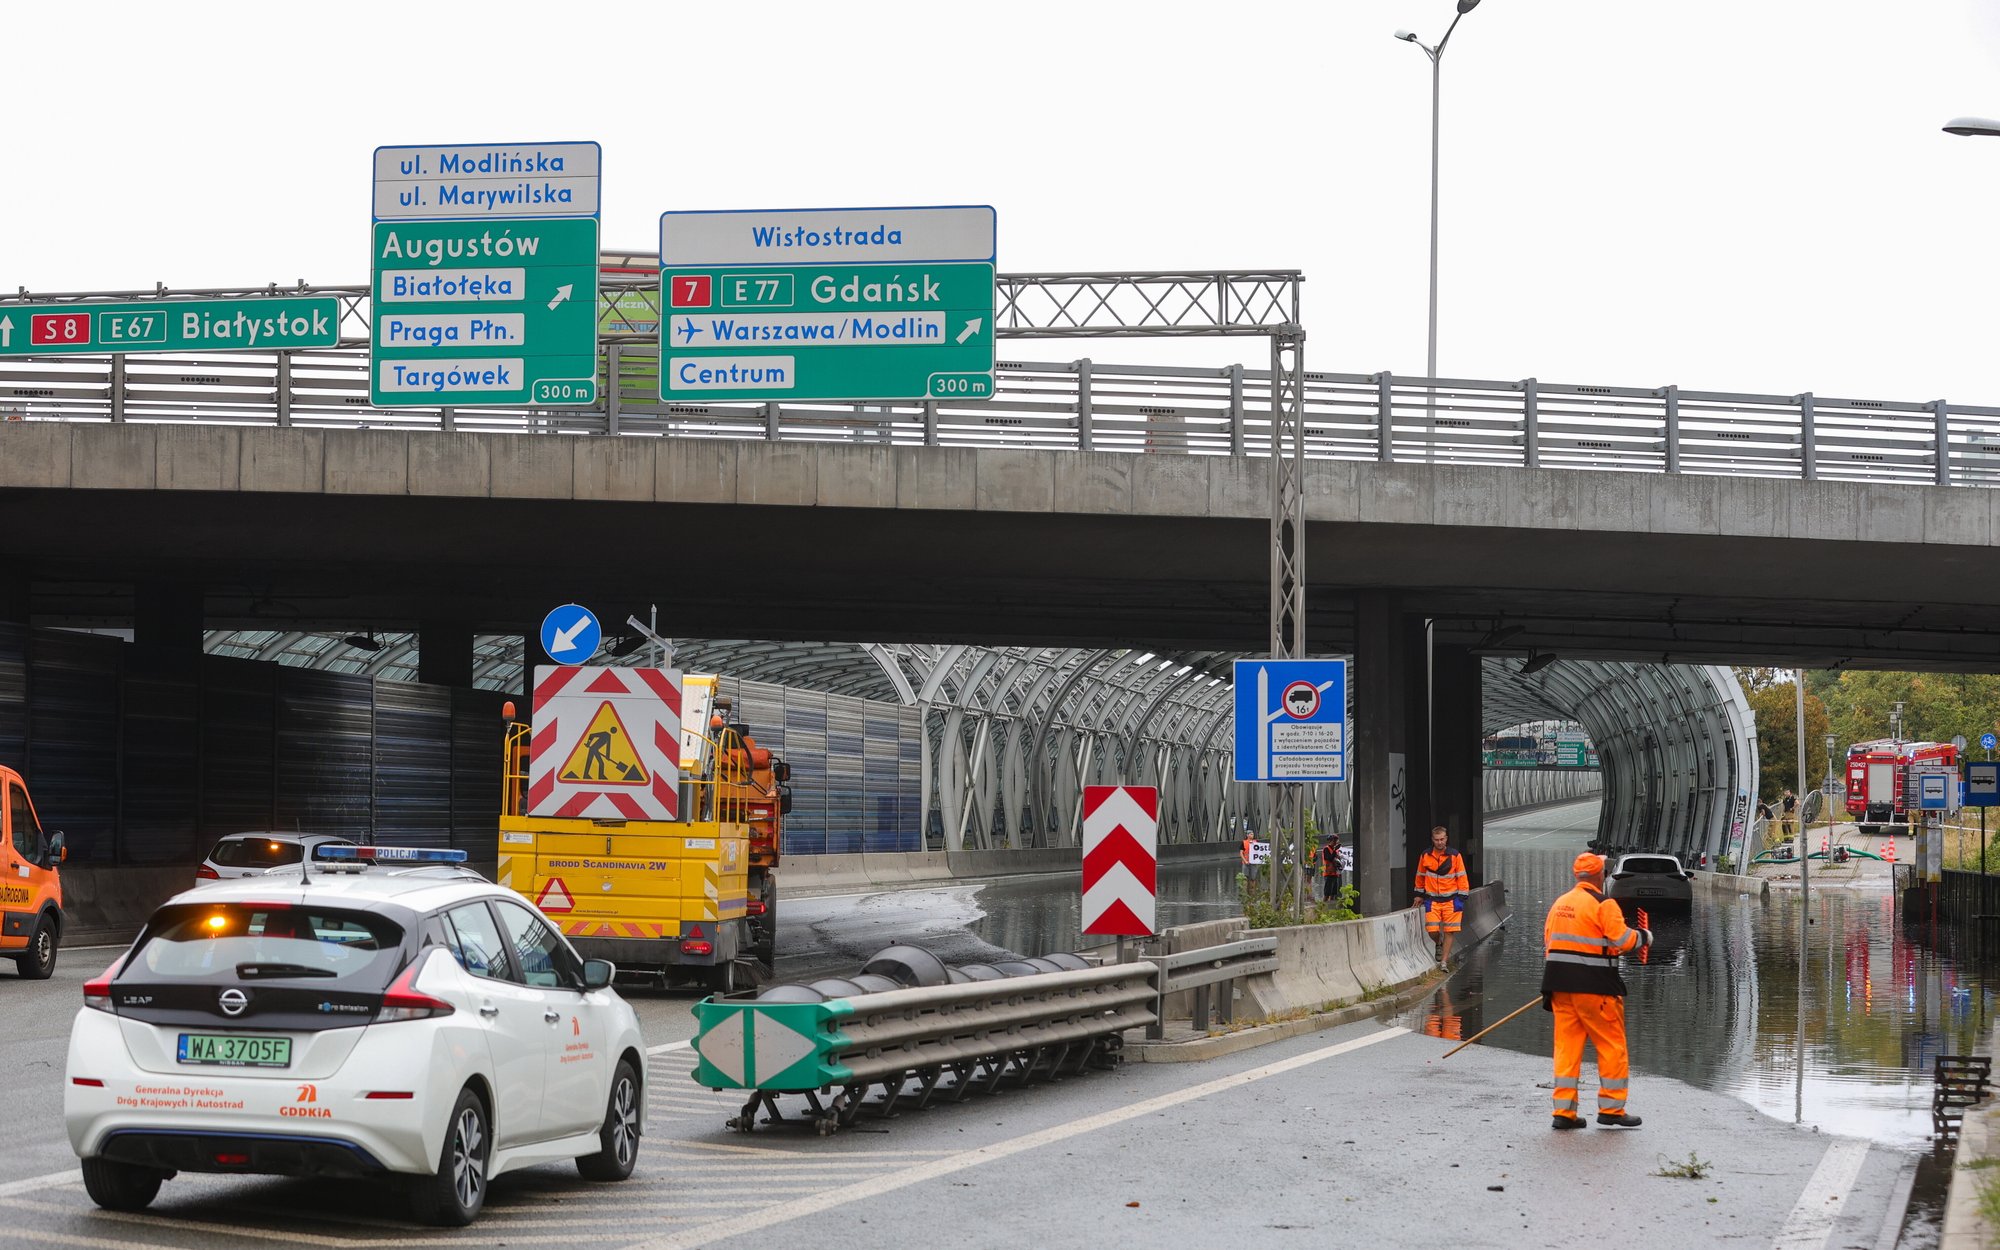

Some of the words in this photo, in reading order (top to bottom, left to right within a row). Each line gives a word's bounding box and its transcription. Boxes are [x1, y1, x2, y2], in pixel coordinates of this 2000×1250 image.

[400, 154, 427, 174] ul.
[440, 152, 565, 174] Modlińska
[400, 186, 426, 206] ul.
[439, 183, 572, 210] Marywilska
[753, 225, 902, 248] Wisłostrada
[382, 231, 540, 265] Augustów
[393, 275, 512, 301] Białołęka
[685, 281, 698, 302] 7
[811, 274, 941, 303] Gdańsk
[183, 308, 329, 346] Białystok
[390, 320, 458, 347] Praga
[471, 319, 515, 340] Płn.
[712, 318, 939, 341] Warszawa/Modlin
[394, 365, 510, 392] Targówek
[680, 363, 785, 384] Centrum
[541, 385, 571, 400] 300
[575, 388, 588, 399] m
[937, 379, 967, 393] 300
[973, 383, 985, 393] m
[1296, 705, 1306, 714] 16
[377, 849, 417, 859] POLICJA
[549, 860, 580, 868] BRODD
[649, 861, 667, 871] 2W
[124, 996, 153, 1004] LEAF
[192, 1038, 216, 1058] WA
[225, 1040, 285, 1061] 3705F
[135, 1085, 181, 1095] Generalna
[184, 1087, 223, 1098] Dyrekcja
[117, 1096, 138, 1108] Dróg
[141, 1097, 188, 1109] Krajowych
[197, 1099, 243, 1109] Autostrad
[279, 1106, 332, 1118] GDDKiA
